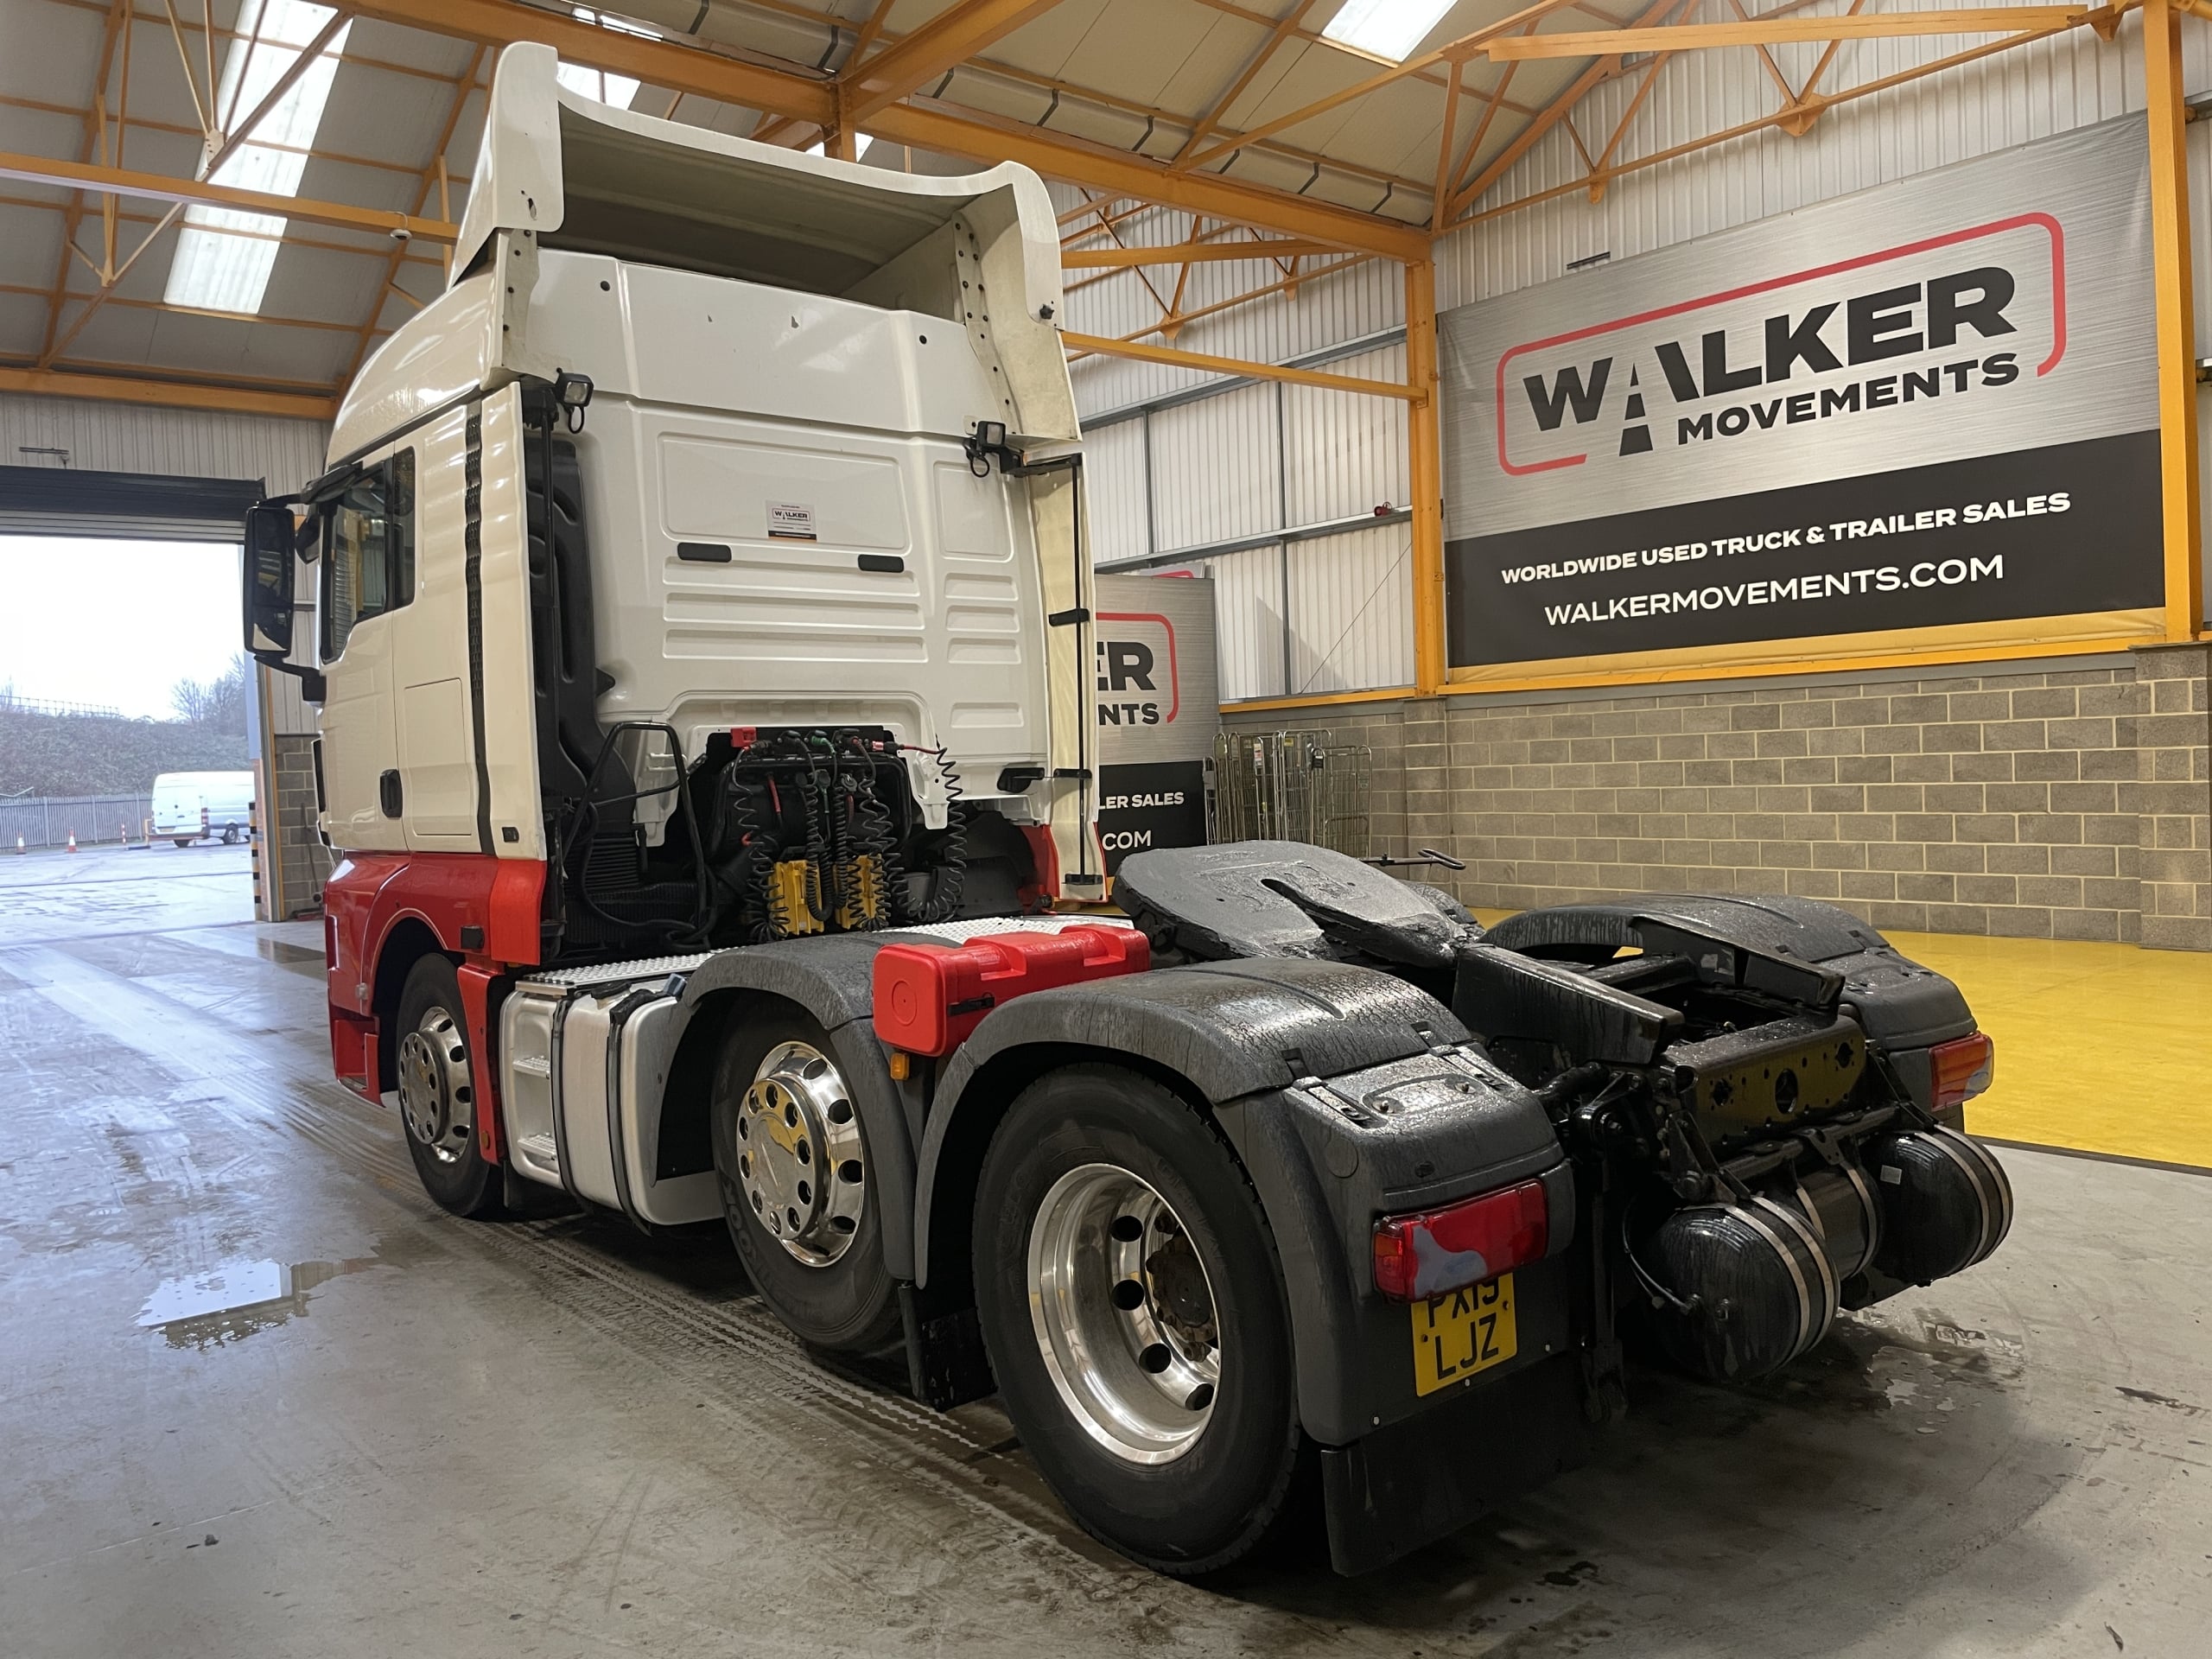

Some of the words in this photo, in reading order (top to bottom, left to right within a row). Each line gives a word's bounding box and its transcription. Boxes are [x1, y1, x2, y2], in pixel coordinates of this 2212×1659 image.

[1522, 266, 2018, 456] WALKER
[1678, 353, 2019, 445] MOVEMENTS
[774, 511, 808, 520] WALKER
[1502, 553, 1637, 584] WORLDWIDE
[1642, 543, 1707, 566] USED
[1712, 531, 1802, 556] TRUCK
[1805, 525, 1826, 544] &
[1829, 507, 1957, 541] TRAILER
[1962, 493, 2071, 523] SALES
[1544, 555, 2005, 626] WALKERMOVEMENTS.COM
[1131, 791, 1185, 808] SALES
[1427, 1276, 1500, 1328] PX19
[1434, 1313, 1499, 1380] LJZ
